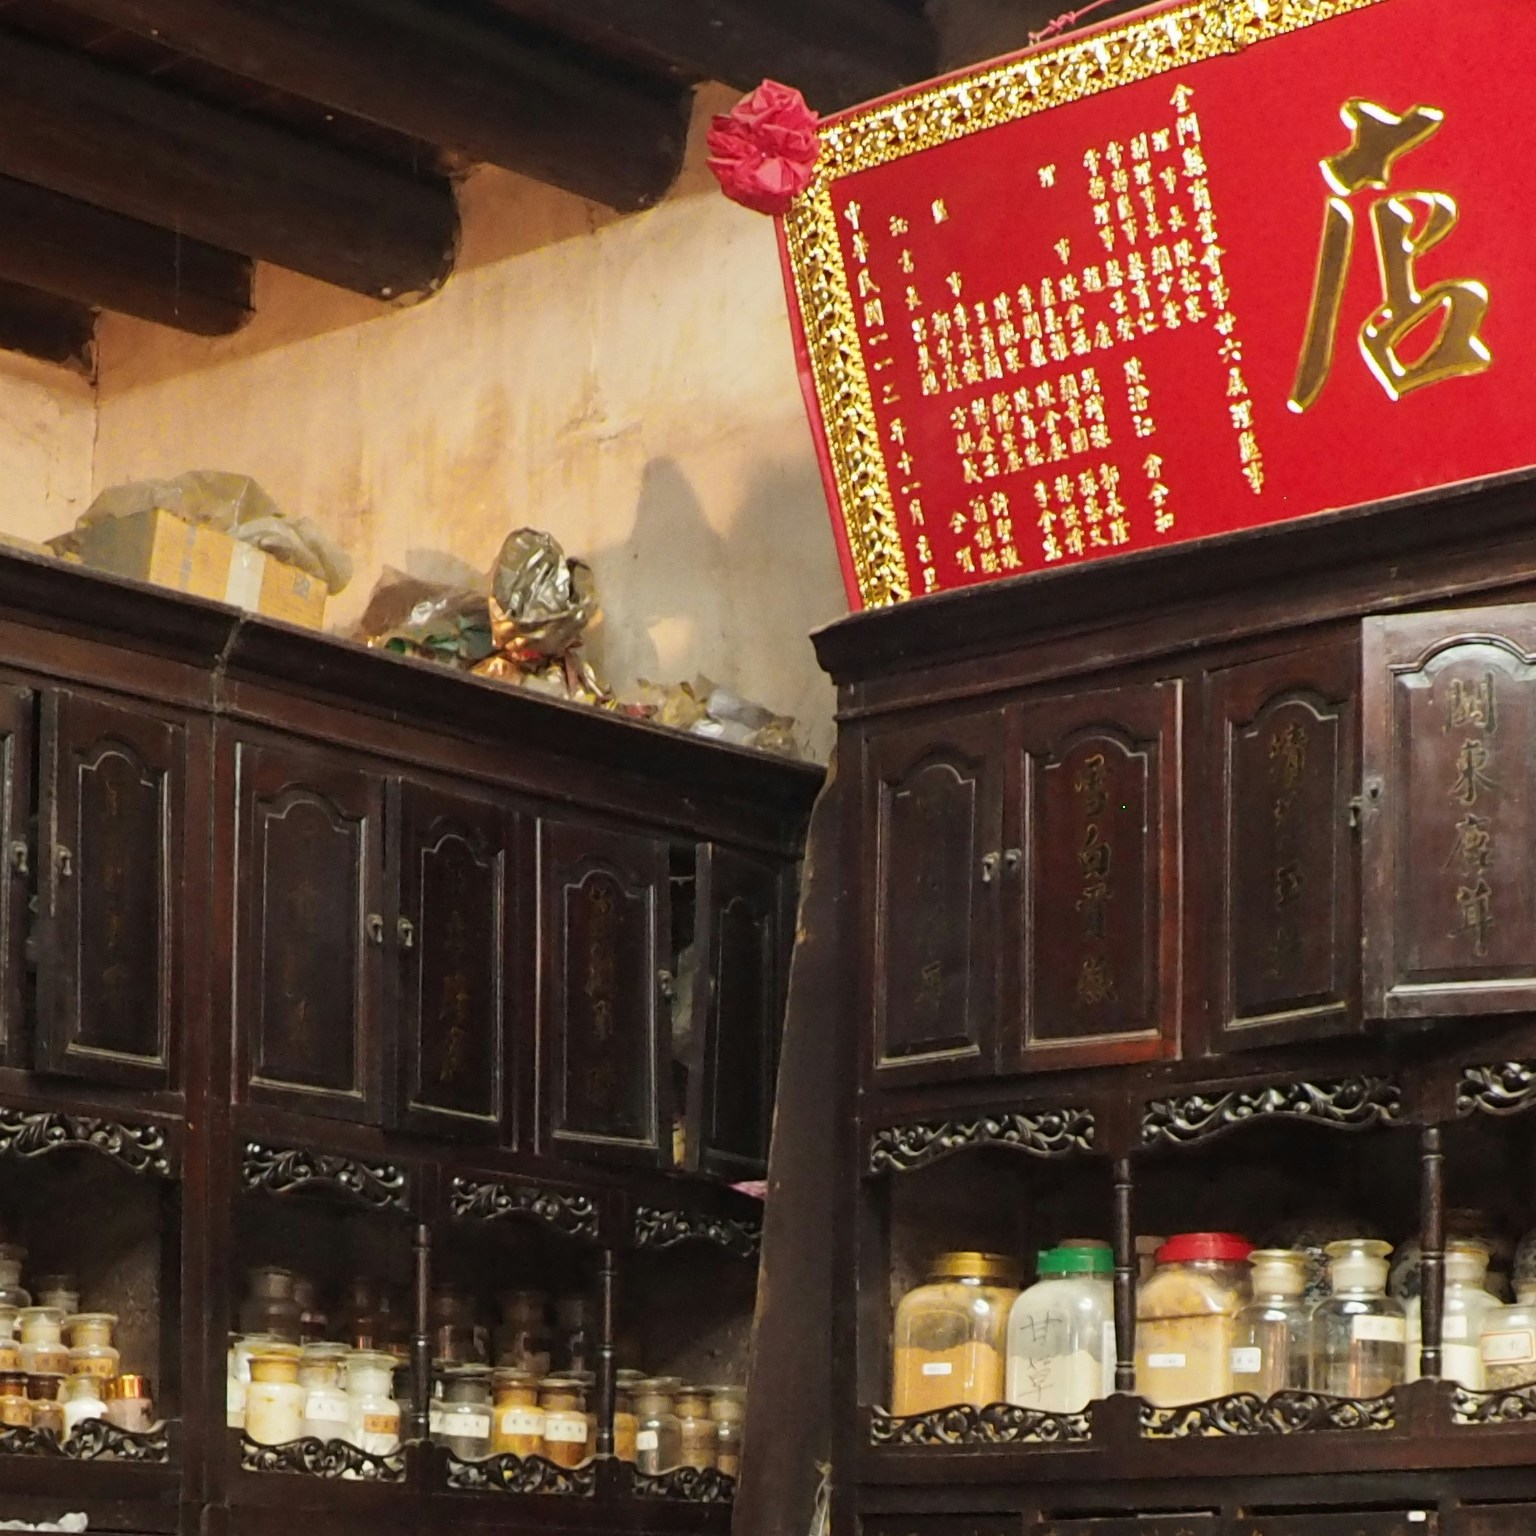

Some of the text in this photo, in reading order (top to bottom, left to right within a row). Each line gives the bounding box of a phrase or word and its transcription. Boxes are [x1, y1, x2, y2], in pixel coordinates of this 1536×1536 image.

[1130, 131, 1164, 239] 副理事長
[1151, 127, 1187, 233] 理事長
